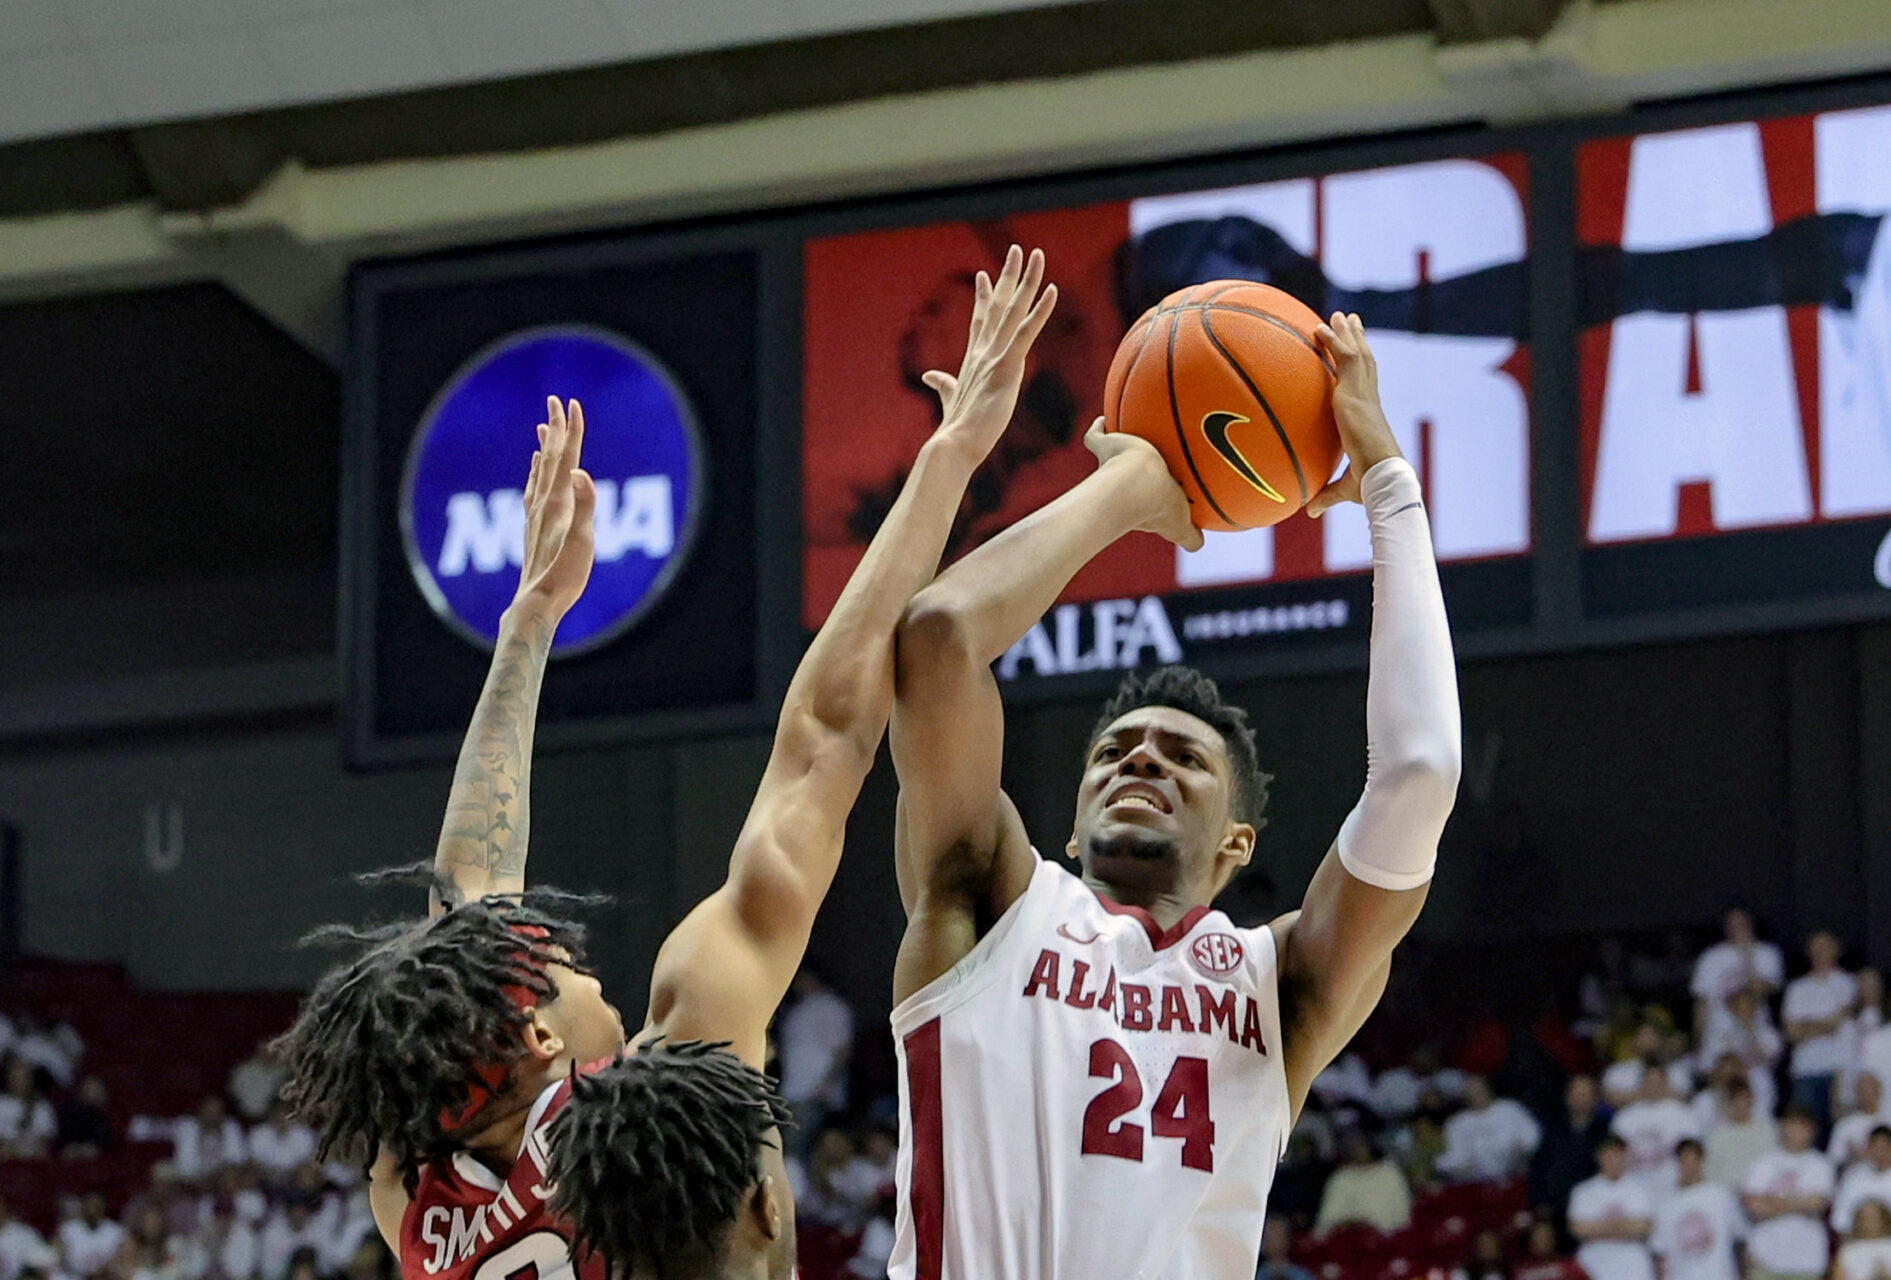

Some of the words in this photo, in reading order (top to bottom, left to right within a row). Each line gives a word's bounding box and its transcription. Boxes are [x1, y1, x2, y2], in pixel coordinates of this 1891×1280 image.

[1130, 106, 1891, 587] RA
[997, 595, 1183, 680] ALFA
[1023, 948, 1268, 1056] ALABAMA
[1195, 935, 1240, 971] SEC
[1081, 1038, 1215, 1173] 24
